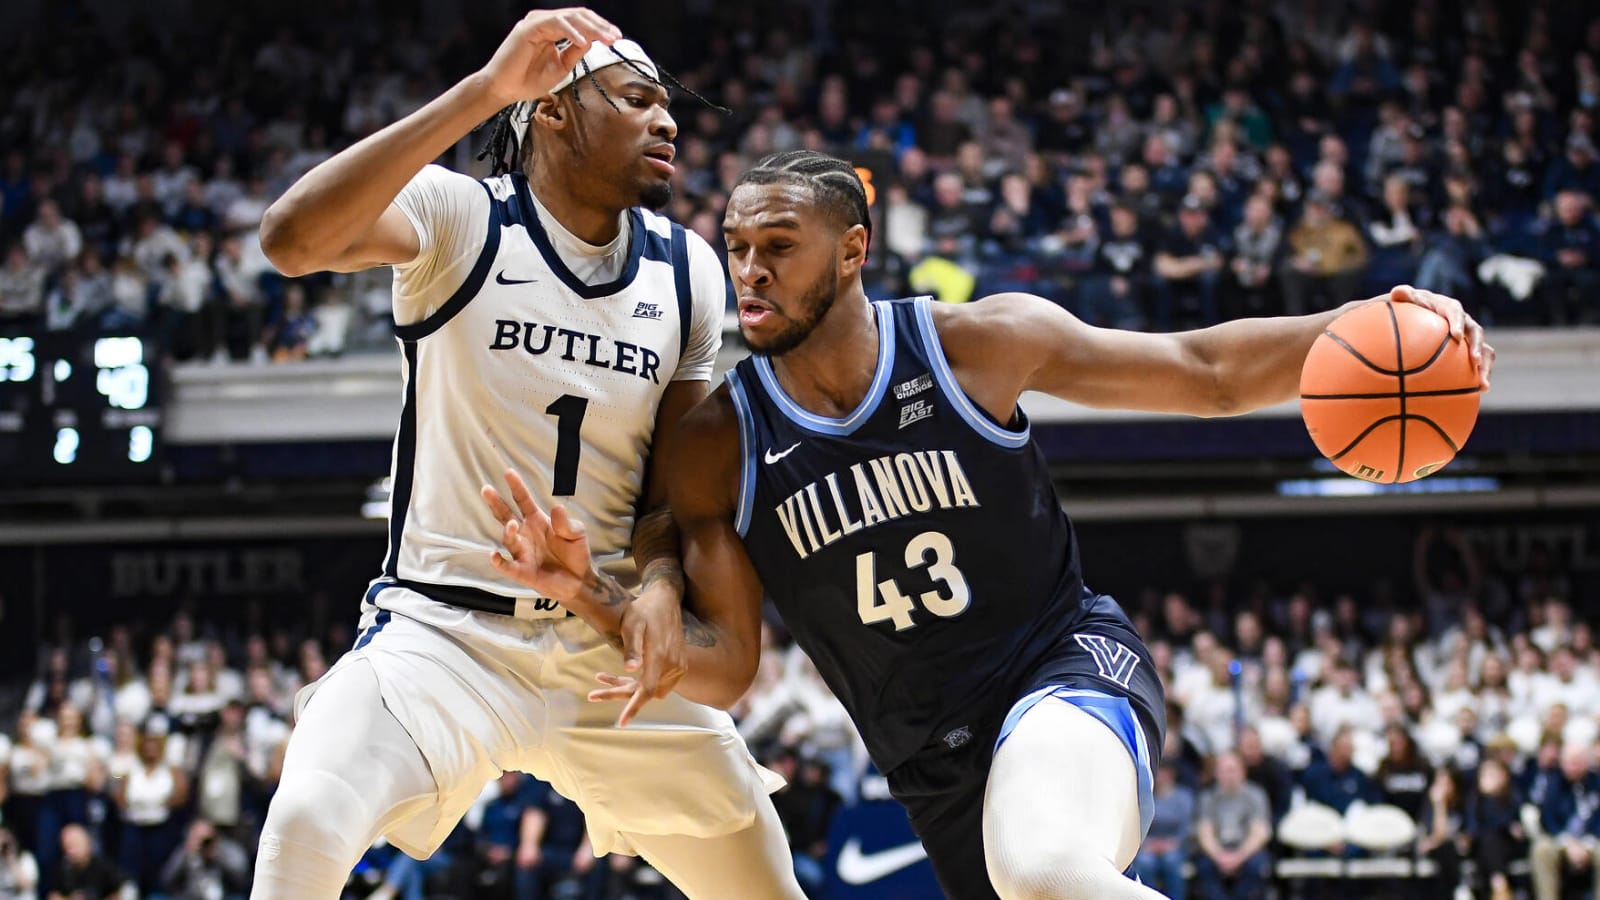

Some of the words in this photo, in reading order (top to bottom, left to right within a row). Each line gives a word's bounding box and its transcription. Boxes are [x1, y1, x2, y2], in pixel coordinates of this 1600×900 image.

[633, 309, 665, 318] EAST
[637, 301, 659, 311] BIG
[489, 319, 660, 385] BUTLER
[899, 405, 934, 425] EAST
[901, 400, 926, 415] BIG
[545, 394, 589, 496] 1
[775, 450, 982, 560] VILLANOVA
[856, 531, 972, 632] 43
